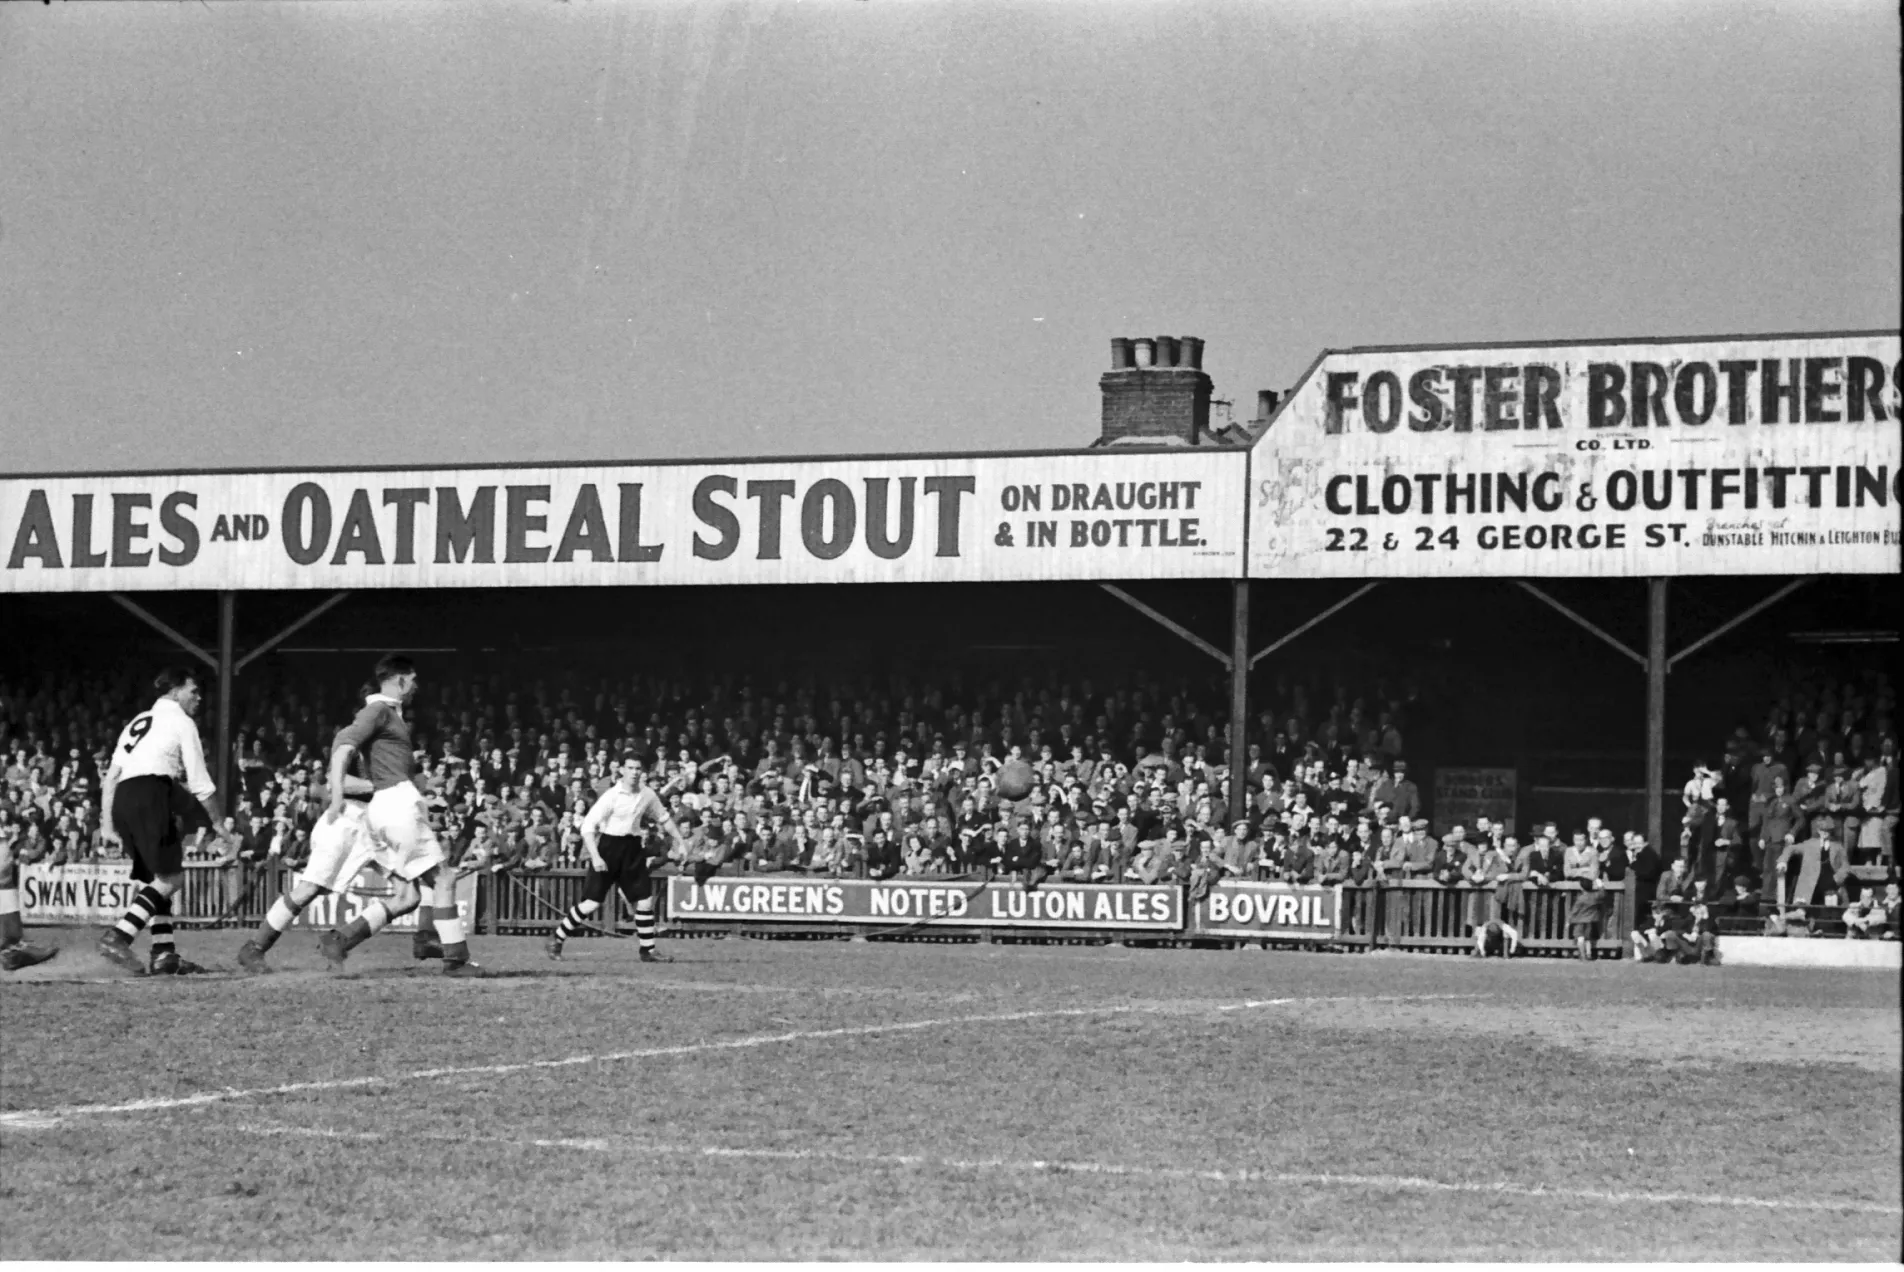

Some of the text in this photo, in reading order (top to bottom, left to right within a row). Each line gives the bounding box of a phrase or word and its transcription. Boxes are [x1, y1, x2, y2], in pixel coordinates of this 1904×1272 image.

[1325, 360, 1564, 436] FOSTER
[1575, 438, 1655, 451] CO. LTD.
[1001, 481, 1202, 512] ON DRAUGHT
[1324, 471, 1563, 517] CLOTHING
[1576, 484, 1599, 512] &
[6, 474, 976, 569] ALES AND OATMEAL STOUT
[994, 518, 1207, 549] & IN BOTTLE.
[1324, 522, 1691, 553] 22 & 24 GEORGE ST.
[1702, 532, 1764, 547] DUNSTABLE
[1770, 530, 1817, 546] HITCHIN
[1828, 528, 1881, 545] LEIGHTON
[123, 716, 153, 755] 9
[24, 876, 77, 909] SWAN
[870, 886, 969, 917] NOTED
[991, 886, 1086, 920] LUTON
[1094, 890, 1171, 922] ALES
[1208, 891, 1332, 928] BOVRIL
